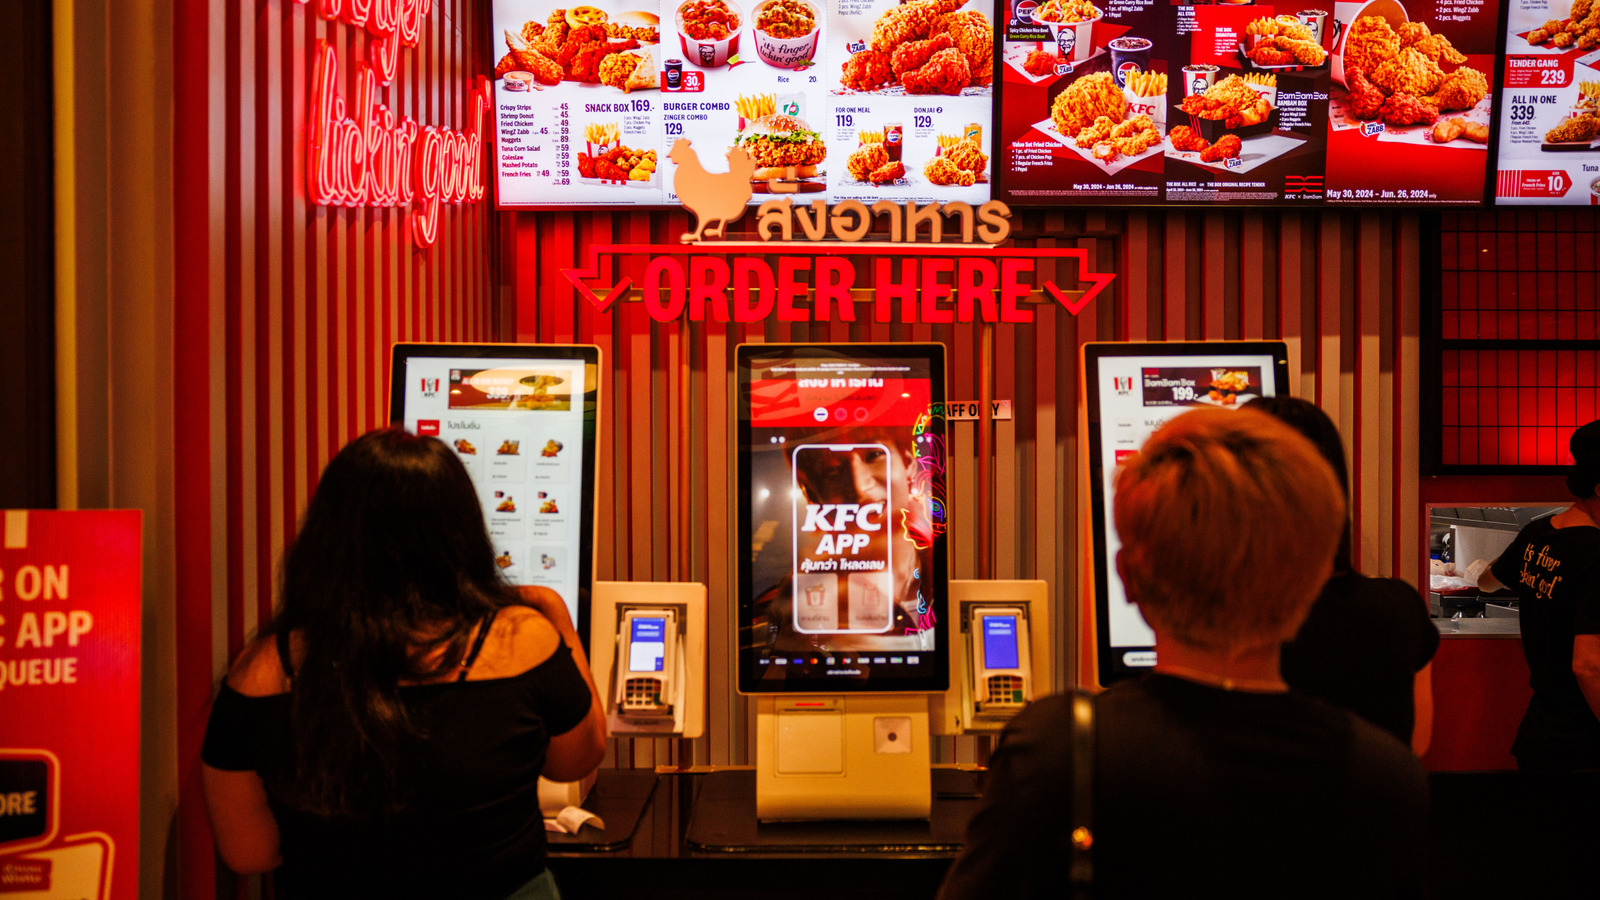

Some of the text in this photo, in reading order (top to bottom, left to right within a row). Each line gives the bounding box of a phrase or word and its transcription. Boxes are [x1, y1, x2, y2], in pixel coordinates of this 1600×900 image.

[585, 104, 612, 112] SNACK
[614, 104, 629, 112] BOX
[1126, 102, 1156, 115] KFC
[1327, 190, 1341, 199] May
[1342, 190, 1354, 198] 30,
[1355, 190, 1373, 198] 2024
[1398, 190, 1408, 199] 26,
[1410, 190, 1428, 198] 2024
[643, 256, 1034, 323] ORDER HERE
[801, 503, 884, 531] KFC
[815, 534, 870, 555] APP
[15, 564, 69, 601] ON
[15, 610, 94, 648] APP
